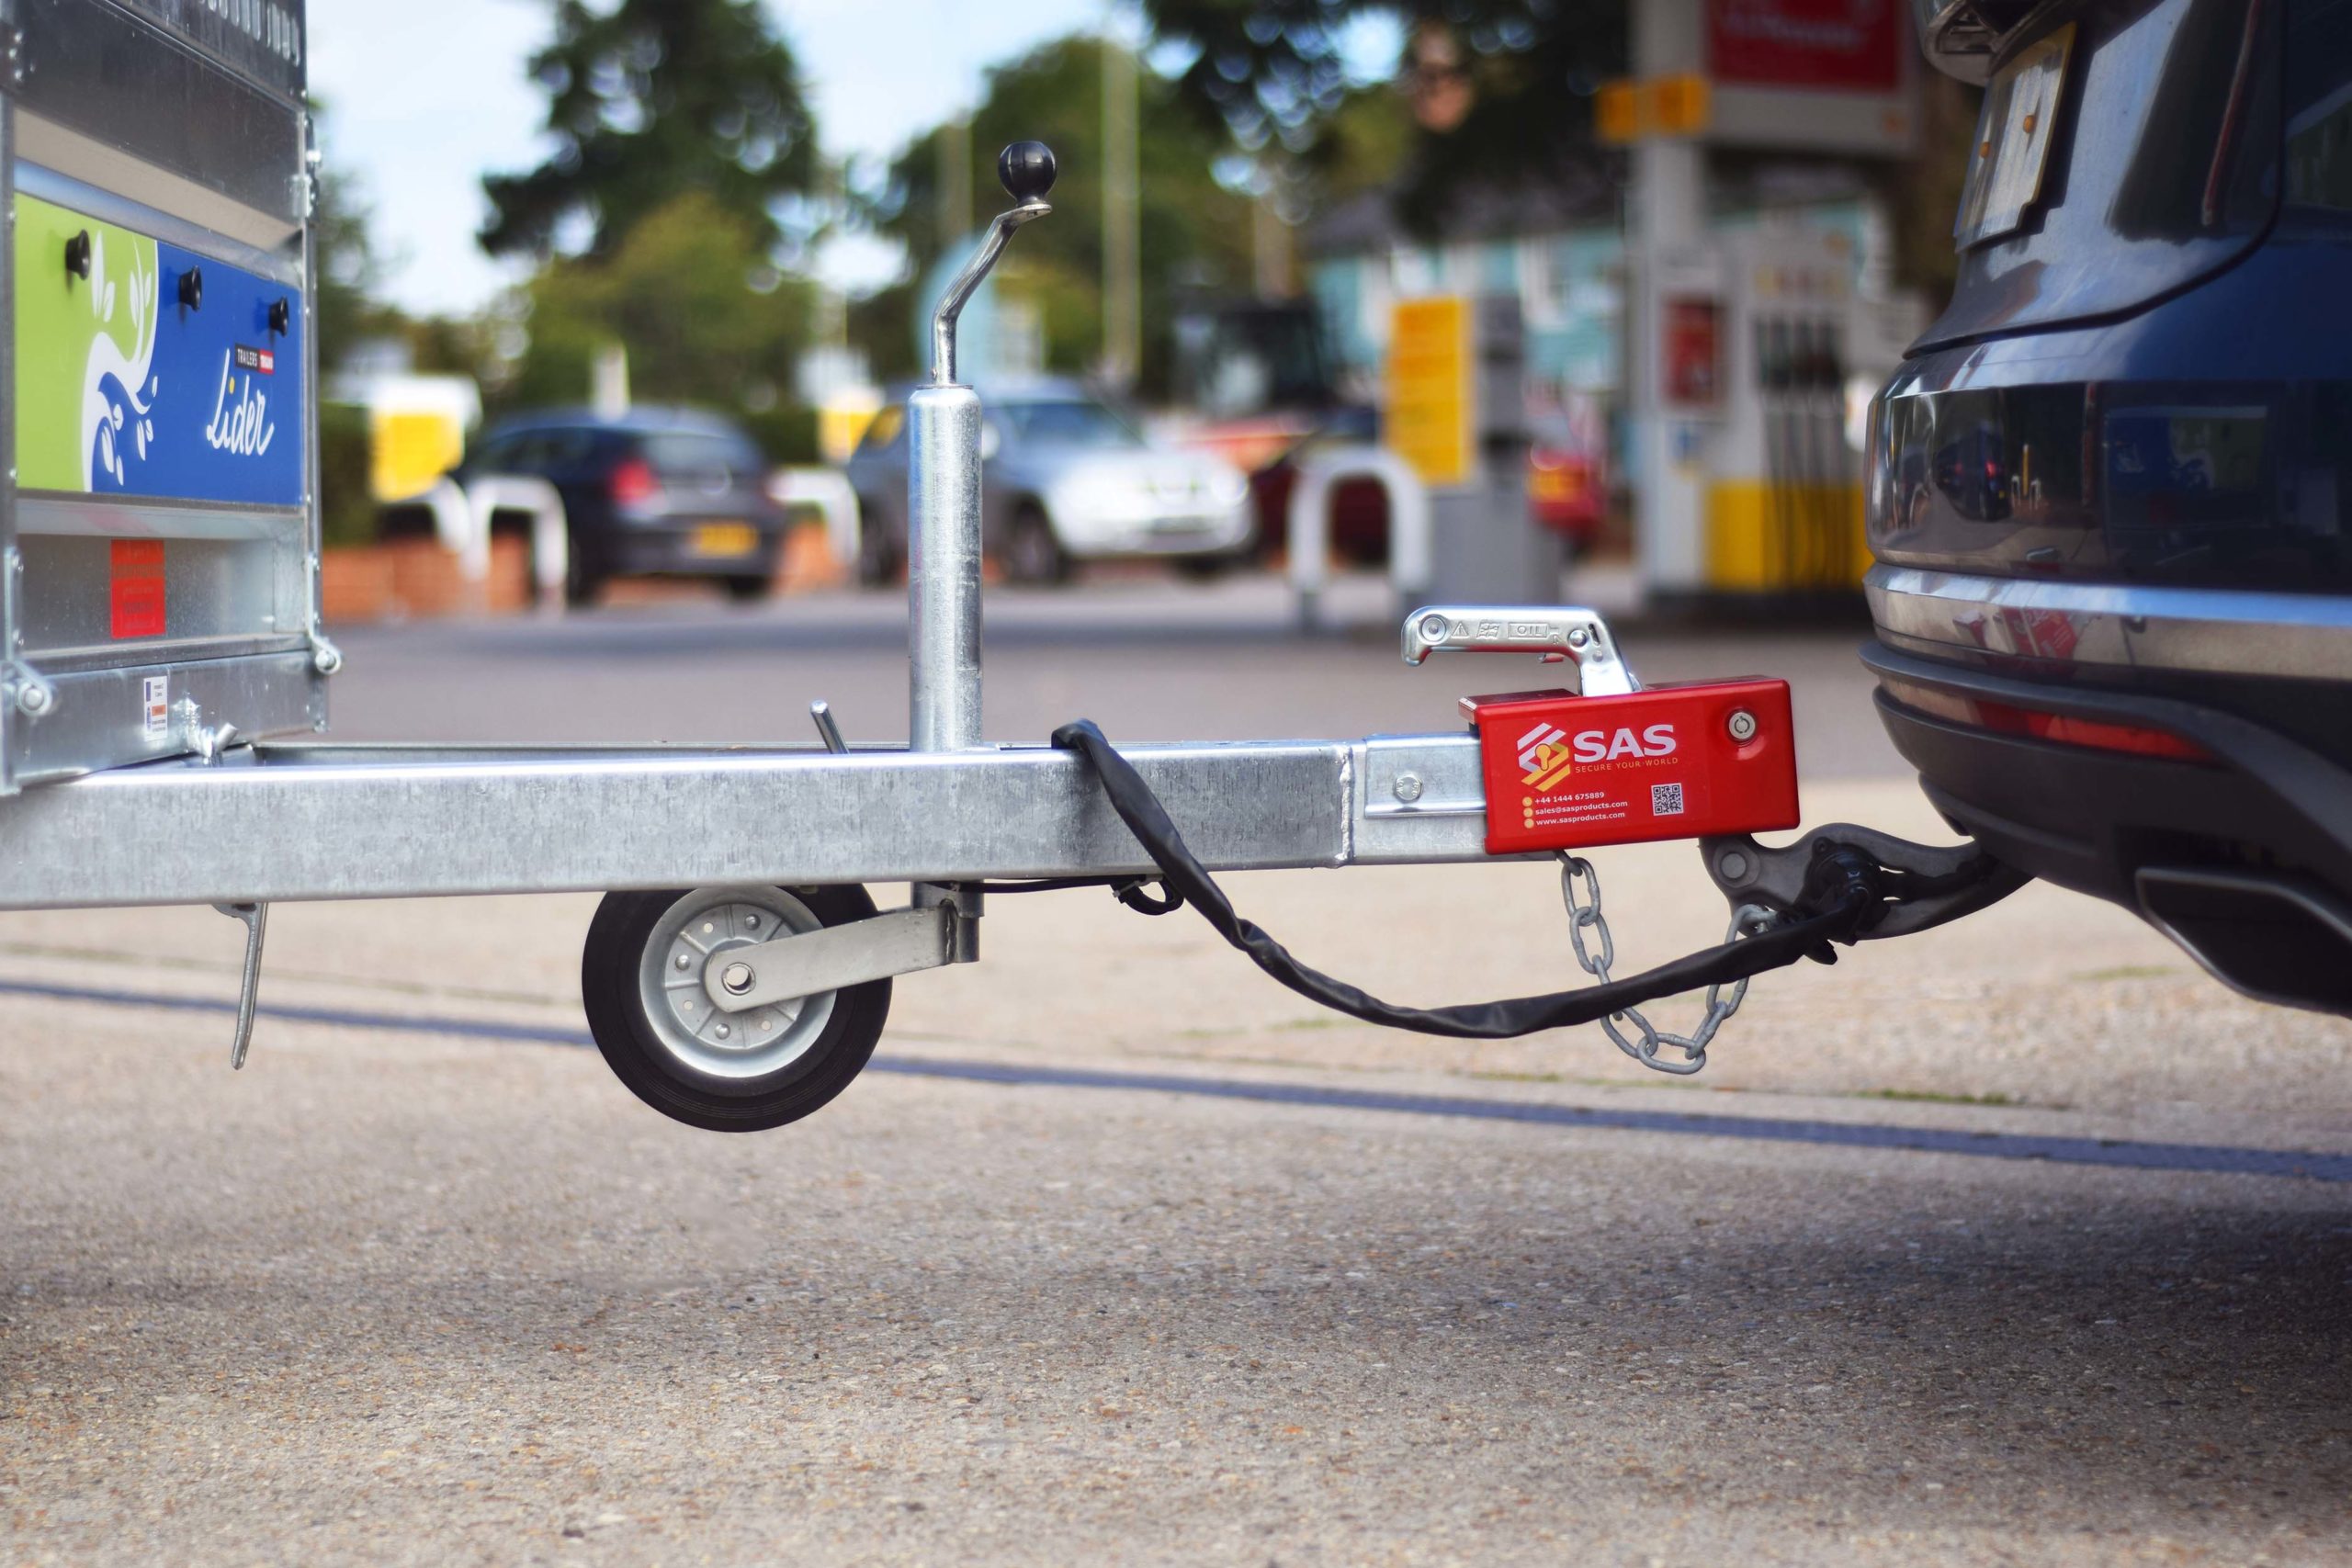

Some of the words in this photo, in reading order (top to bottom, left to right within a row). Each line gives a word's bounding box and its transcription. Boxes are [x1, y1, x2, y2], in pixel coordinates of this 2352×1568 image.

[237, 348, 257, 367] TRAILERS
[207, 348, 274, 456] Lider
[1573, 724, 1677, 762] SAS
[1575, 762, 1611, 773] SECURE
[1616, 761, 1641, 770] YOUR
[1645, 757, 1679, 767] WORLD
[1534, 796, 1551, 805] +44
[1553, 795, 1573, 803] 1444
[1575, 791, 1605, 801] 675889
[1535, 800, 1628, 816] sales@sasproducts.com
[1535, 812, 1625, 826] www.sasproducts.com
